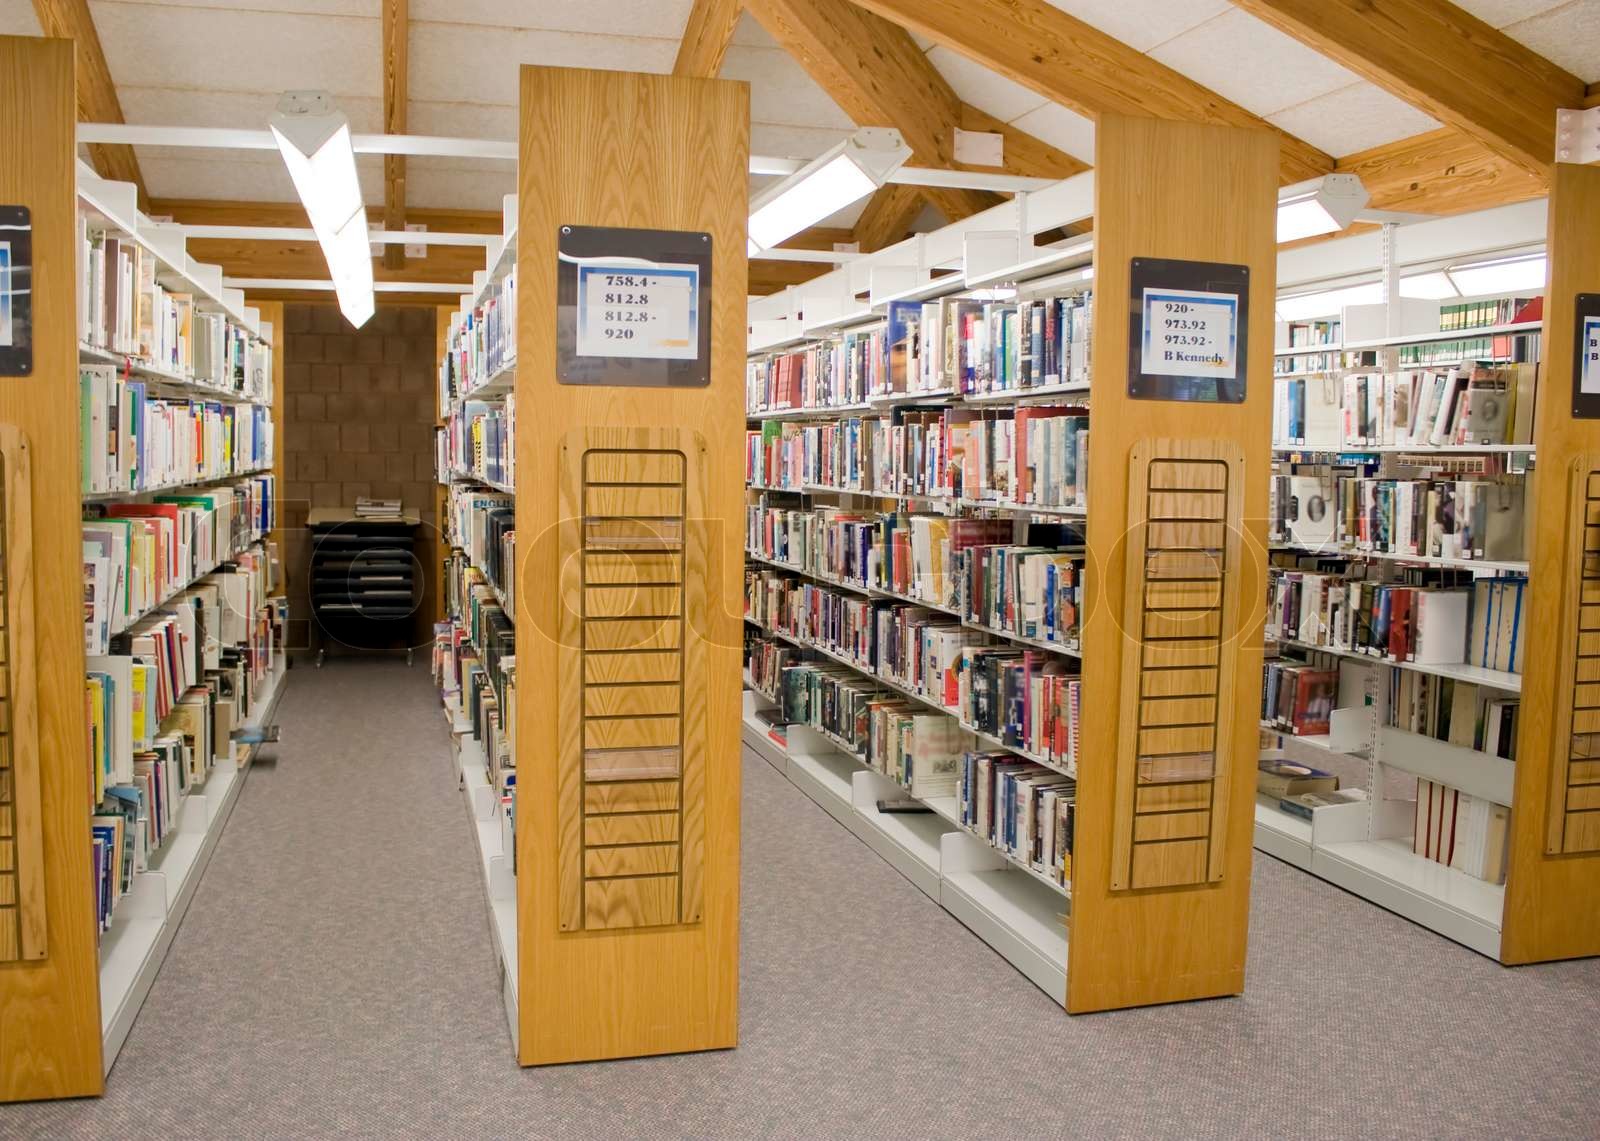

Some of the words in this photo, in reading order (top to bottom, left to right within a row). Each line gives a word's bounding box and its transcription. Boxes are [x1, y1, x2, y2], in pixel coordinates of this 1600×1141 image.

[605, 276, 648, 287] 758.4
[605, 294, 649, 305] 812.8
[1165, 303, 1188, 314] 920
[605, 311, 649, 323] 812.8
[1165, 319, 1206, 330] 973.92
[604, 328, 634, 339] 920
[1164, 335, 1206, 346] 973.92
[1164, 351, 1173, 361] B
[1176, 351, 1225, 365] Kennedy
